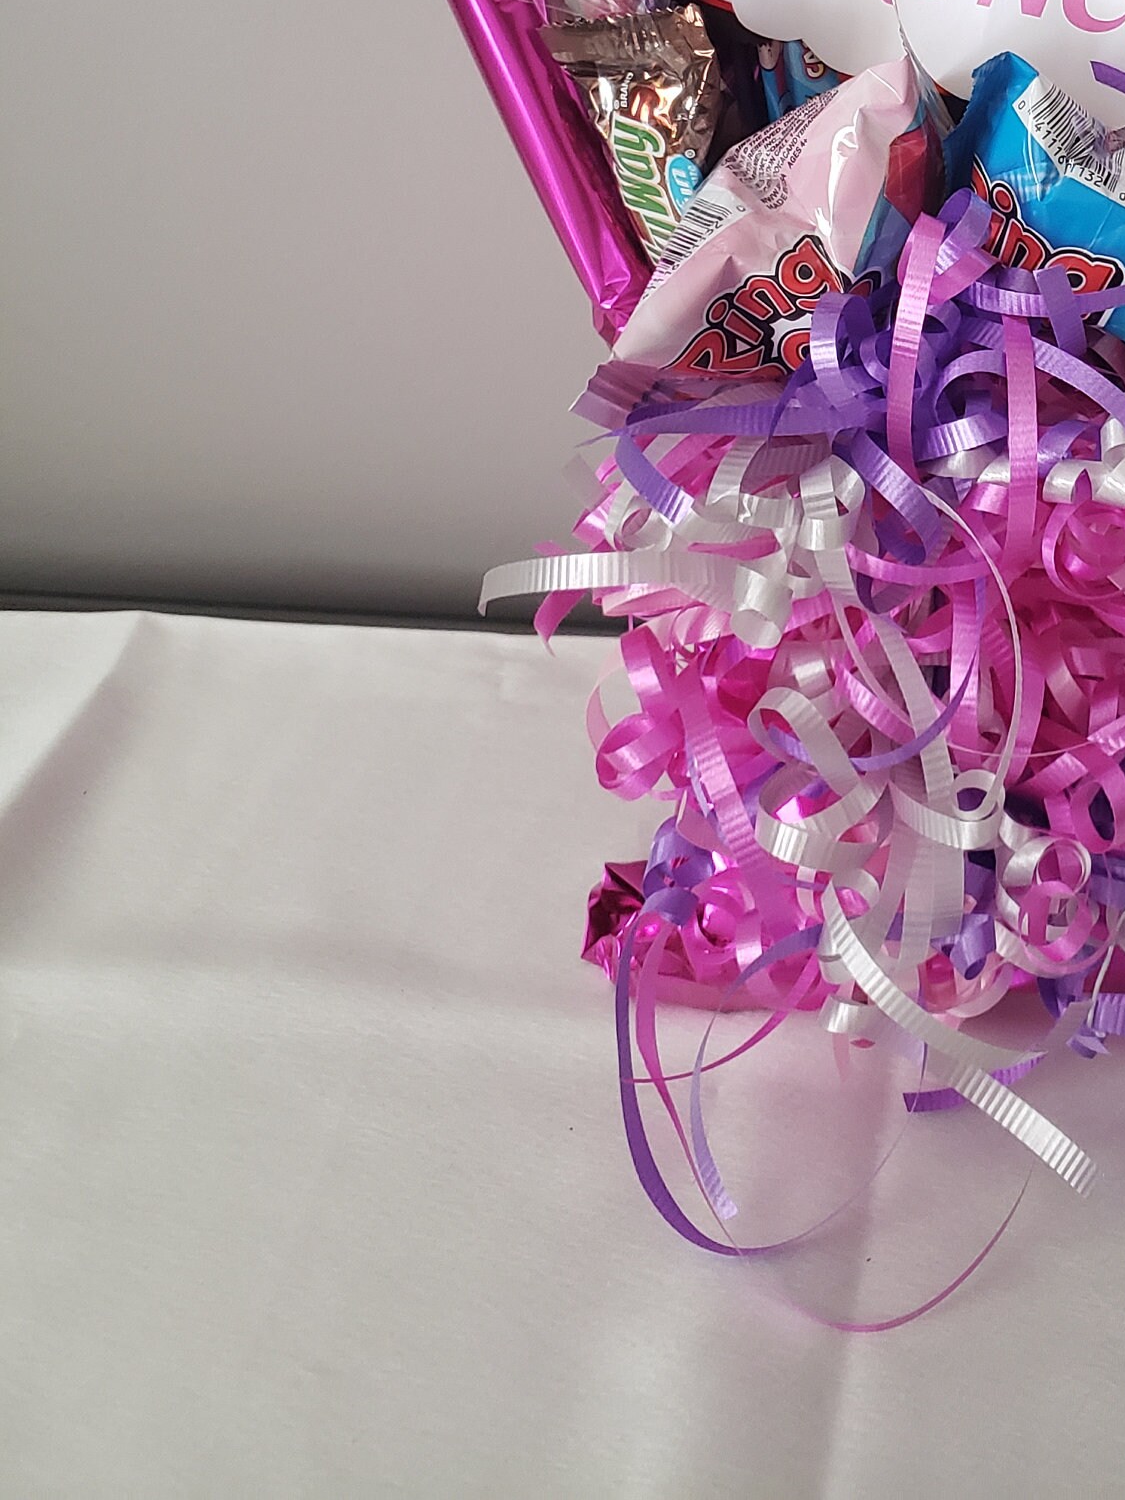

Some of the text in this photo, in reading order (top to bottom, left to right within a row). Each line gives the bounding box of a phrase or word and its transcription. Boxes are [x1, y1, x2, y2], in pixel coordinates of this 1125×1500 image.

[620, 72, 634, 109] BRAND
[1018, 100, 1026, 110] 0
[787, 147, 802, 169] AGES
[971, 155, 1117, 322] ing
[670, 237, 845, 371] Ring
